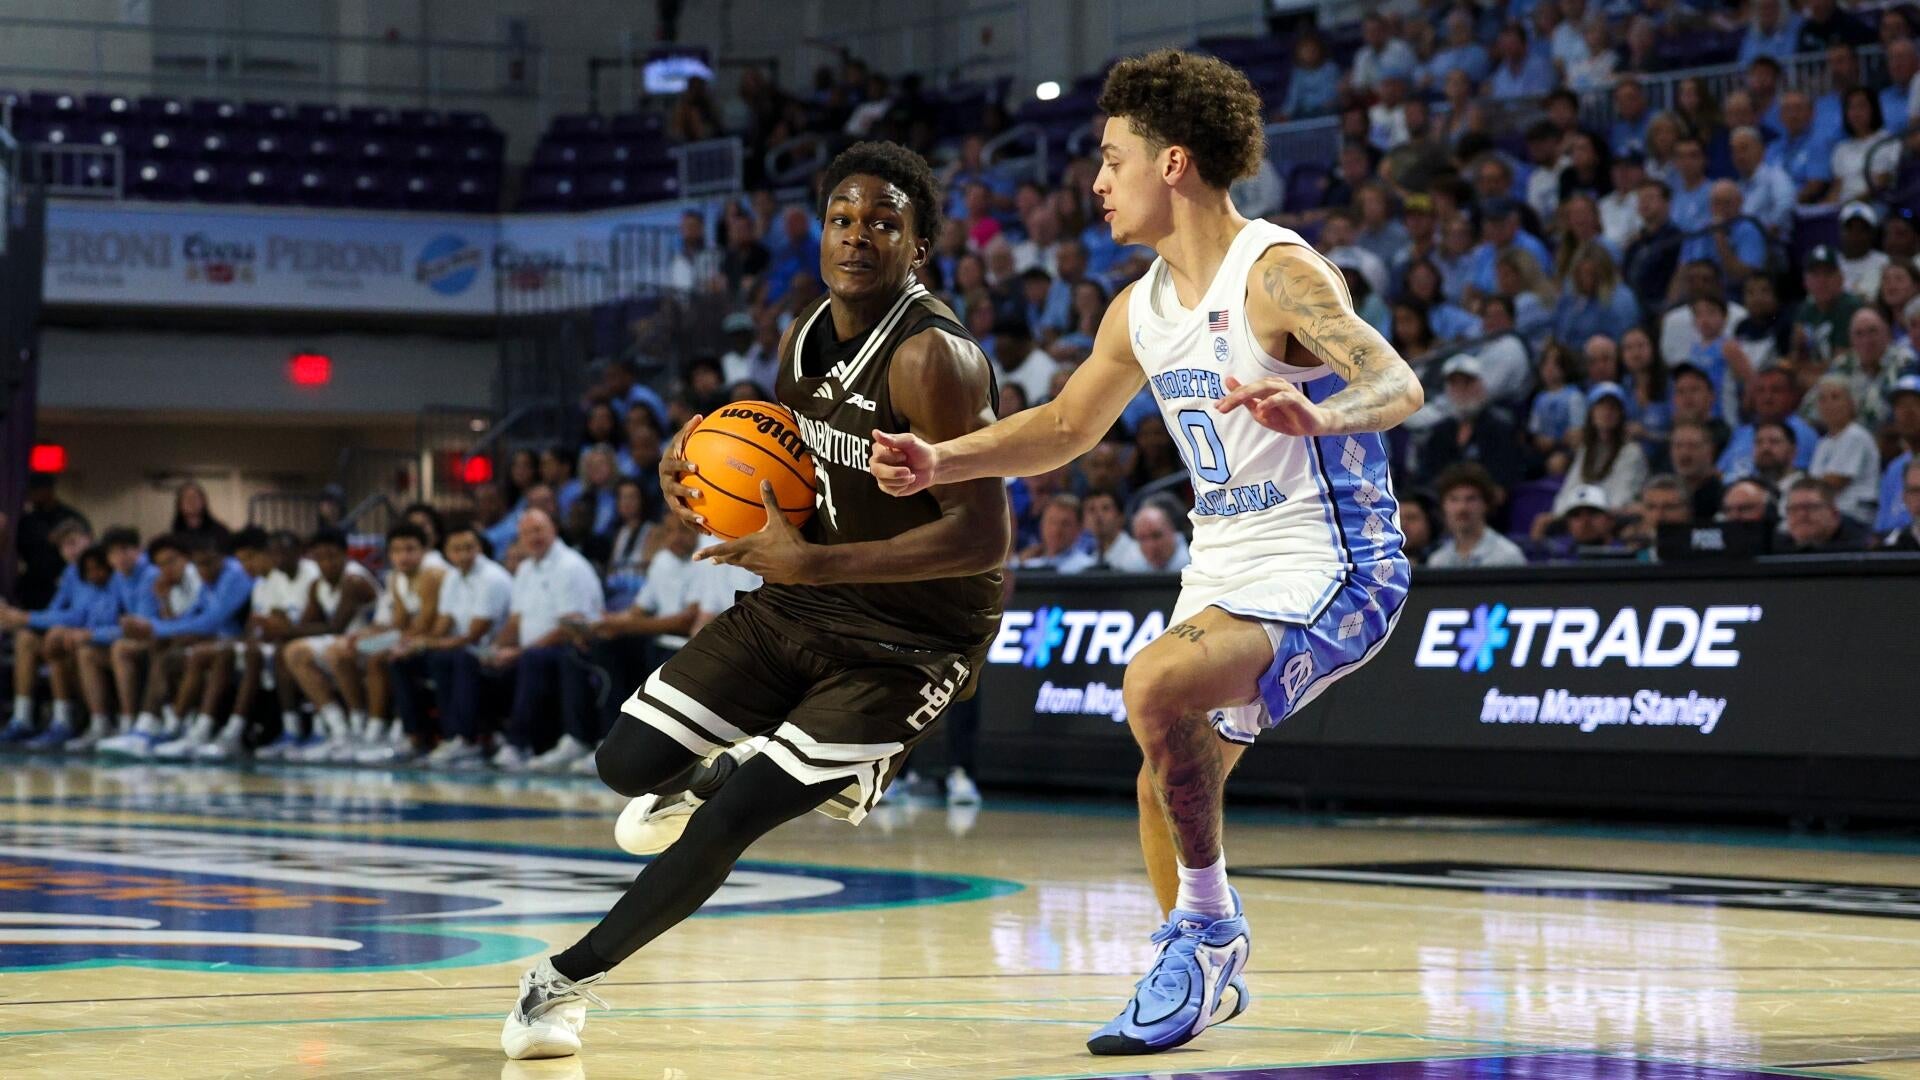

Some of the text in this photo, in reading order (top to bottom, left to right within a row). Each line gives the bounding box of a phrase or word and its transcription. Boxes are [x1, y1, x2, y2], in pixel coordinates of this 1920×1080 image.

[1151, 368, 1226, 400] NORTH
[720, 408, 803, 462] Wilson
[1194, 480, 1288, 516] ROLINA
[986, 604, 1168, 669] ETRA
[1035, 681, 1127, 722] from Morg
[1480, 688, 1727, 734] from Morgan Stanley
